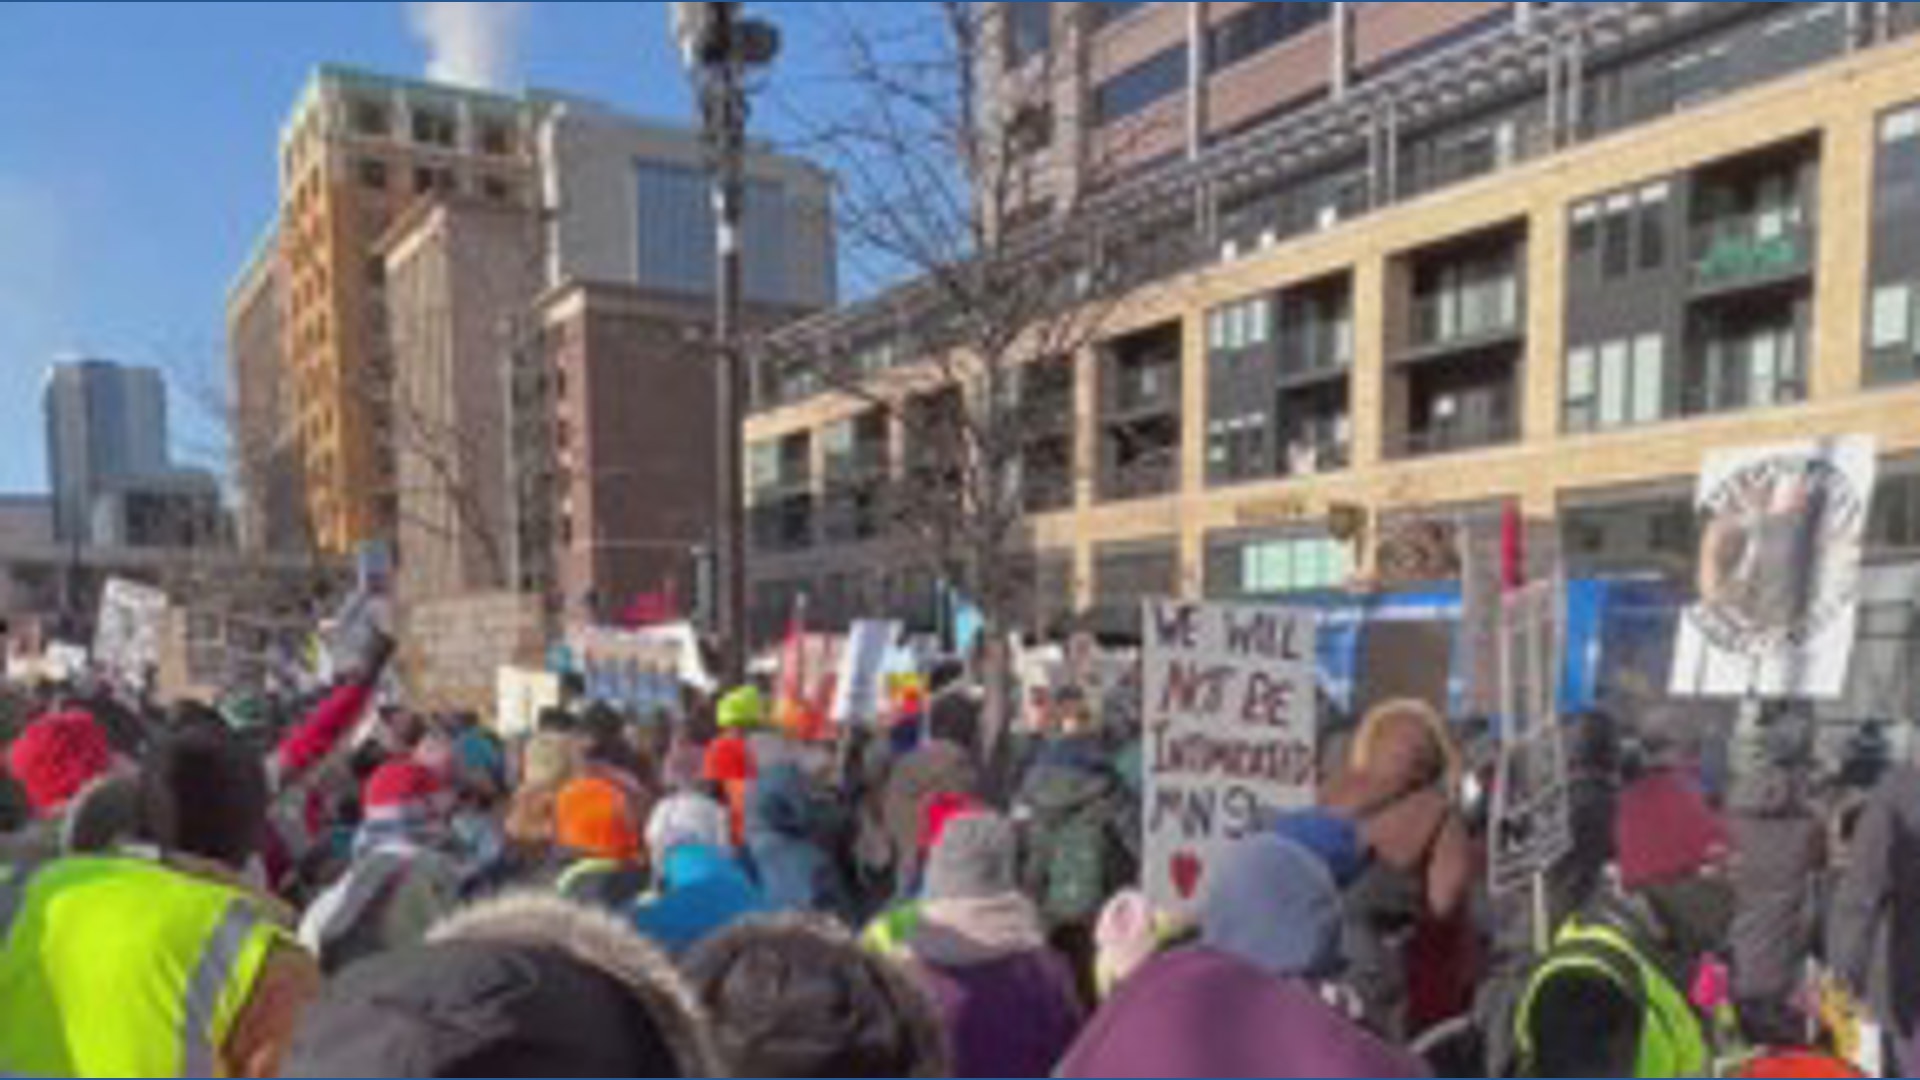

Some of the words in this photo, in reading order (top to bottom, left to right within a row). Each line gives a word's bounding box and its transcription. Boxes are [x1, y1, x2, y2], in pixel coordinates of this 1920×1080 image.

[1156, 606, 1197, 647] WE
[1222, 612, 1301, 660] WILL
[1158, 660, 1237, 714] NOT
[1242, 671, 1293, 726] BE
[1150, 788, 1216, 838] MN
